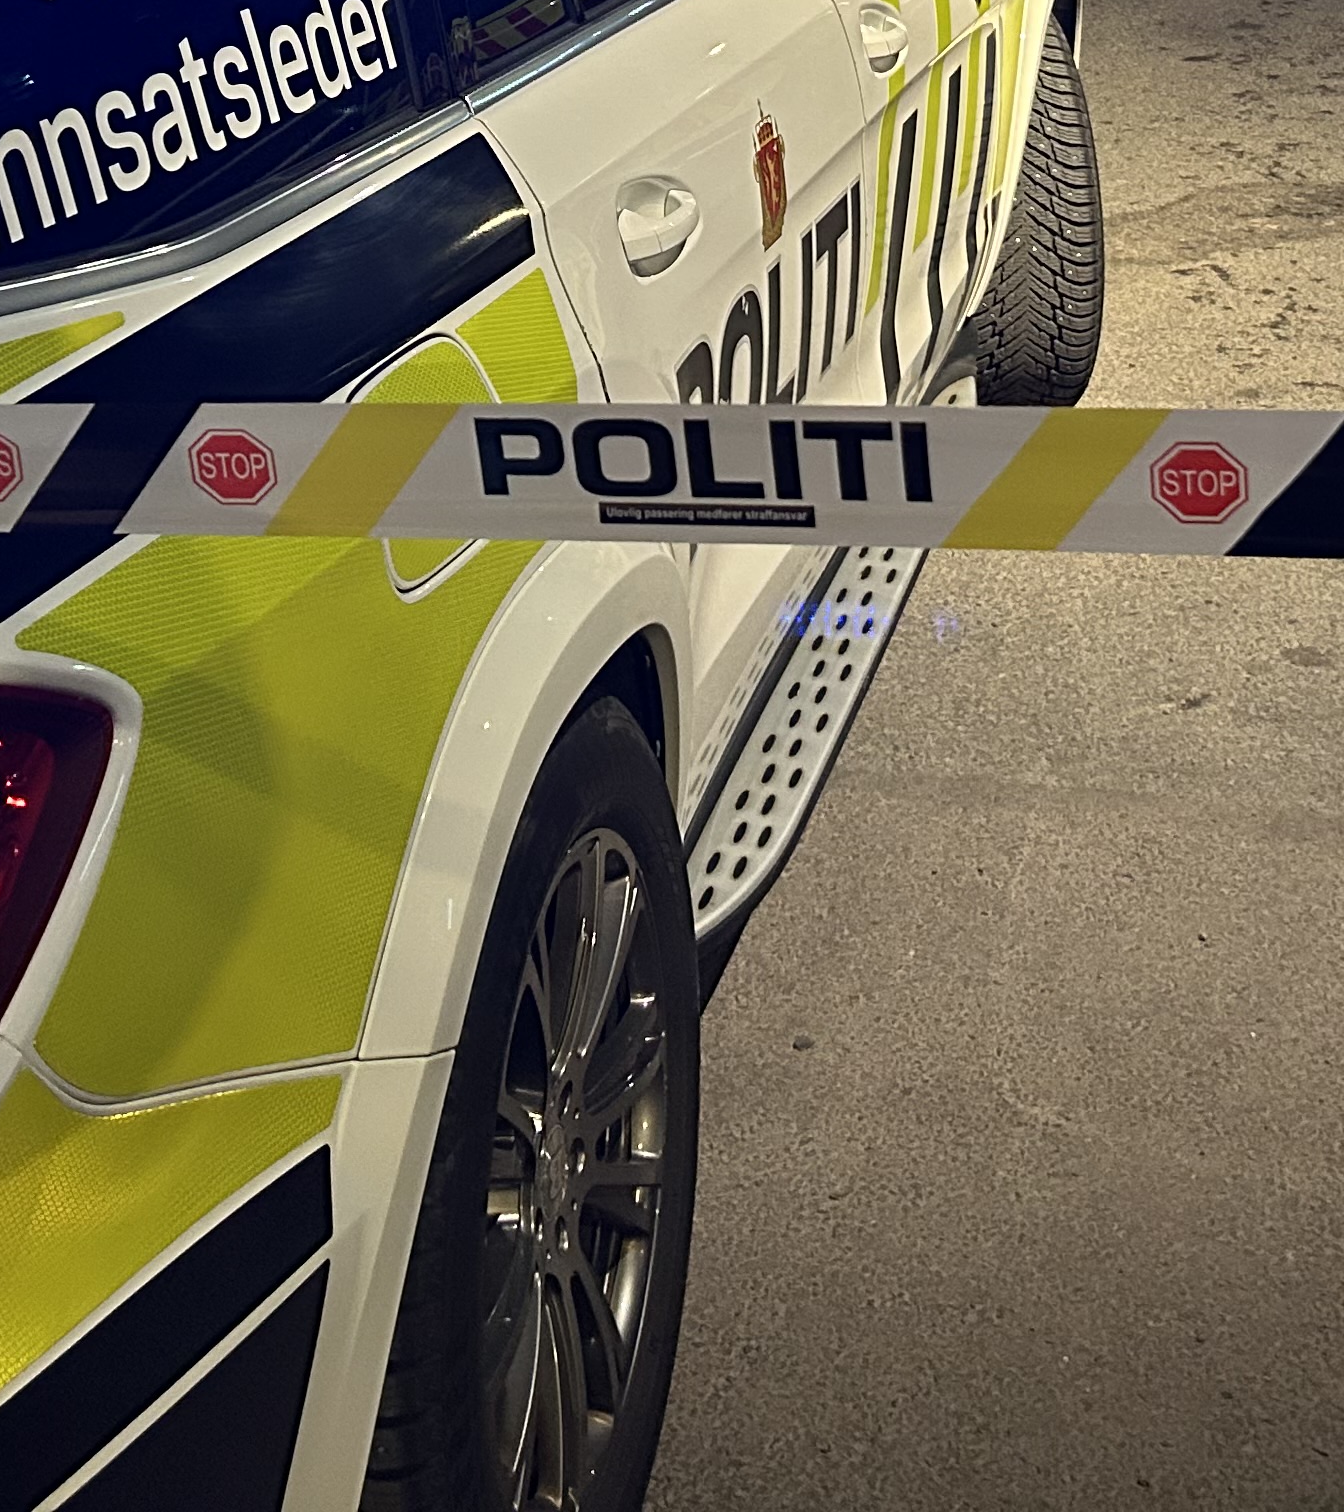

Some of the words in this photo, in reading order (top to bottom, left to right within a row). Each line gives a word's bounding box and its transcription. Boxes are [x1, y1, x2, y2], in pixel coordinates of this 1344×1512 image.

[199, 452, 266, 480] STOP
[473, 417, 934, 503] POLITI
[1162, 469, 1237, 498] STOP
[606, 506, 642, 520] Ulovlig
[644, 507, 695, 521] passering
[745, 509, 808, 522] straffansvar
